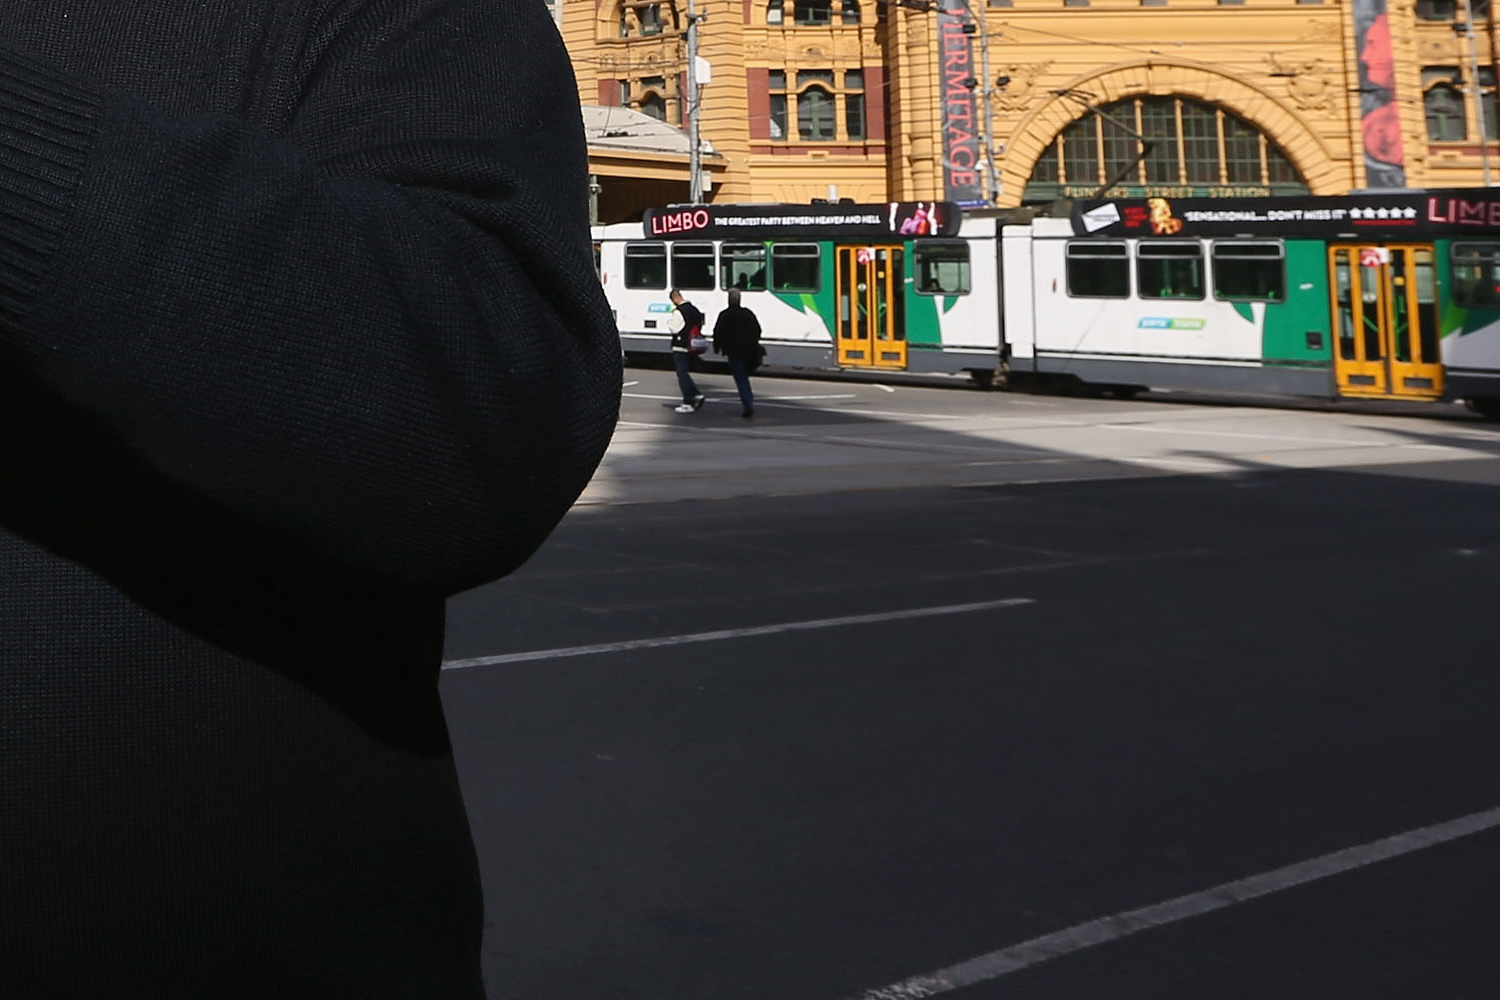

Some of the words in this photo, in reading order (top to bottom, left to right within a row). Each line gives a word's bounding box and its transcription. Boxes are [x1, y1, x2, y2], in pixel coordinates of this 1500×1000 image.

[941, 8, 976, 187] HERMITAGE
[1064, 186, 1129, 198] FLINERS
[1208, 186, 1271, 198] STATION
[652, 210, 709, 234] LIMBO
[714, 217, 728, 226] THE
[728, 217, 760, 226] GREATEST
[761, 216, 781, 225] PARTY
[781, 216, 815, 225] BETWEEN
[815, 215, 845, 225] HEAVEN
[845, 215, 861, 224] AND
[862, 214, 881, 224] HELL
